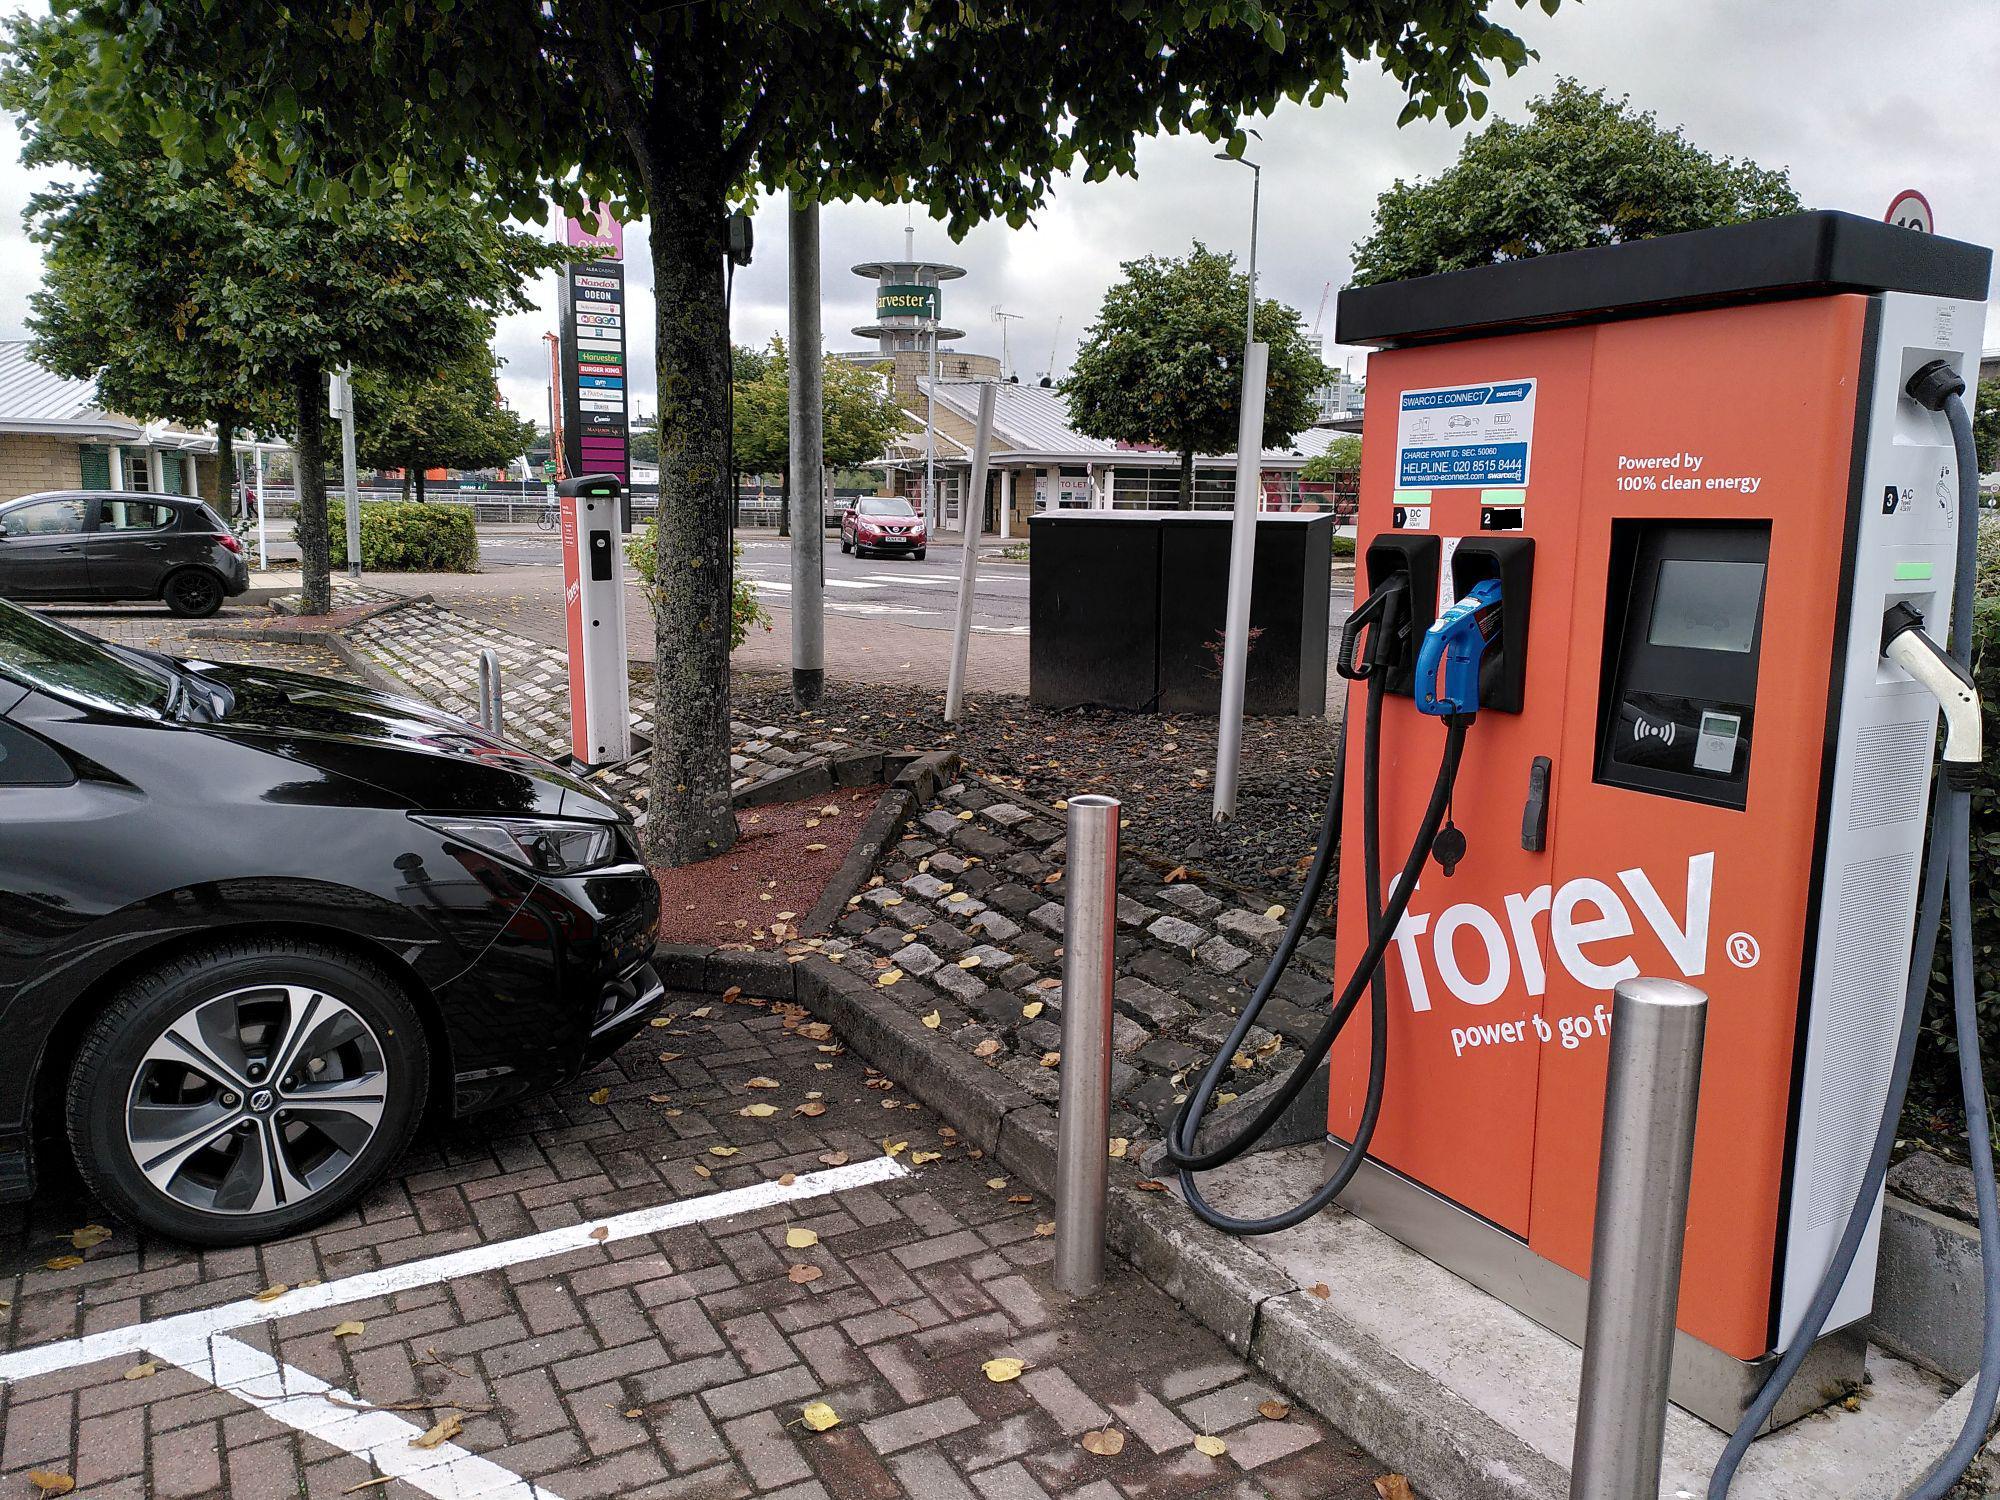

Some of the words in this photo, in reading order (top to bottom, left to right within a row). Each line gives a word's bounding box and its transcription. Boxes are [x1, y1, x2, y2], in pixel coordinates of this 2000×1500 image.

[580, 278, 615, 288] Nando's
[584, 289, 611, 300] ODEON
[581, 315, 616, 325] MECCA
[582, 352, 618, 362] Harvester
[580, 365, 604, 373] BURGER
[1402, 395, 1436, 407] SWARCO
[1403, 450, 1430, 460] CHARGE
[1430, 449, 1451, 459] POINT
[1451, 449, 1460, 458] ID:
[1461, 448, 1477, 457] SEC.
[1402, 462, 1451, 474] HELPLINE:
[1453, 460, 1471, 472] 020
[1472, 459, 1496, 471] 8515
[1498, 458, 1522, 470] 8444
[1618, 452, 1681, 470] Powered
[1684, 452, 1704, 472] by
[1401, 472, 1485, 482] www.swarco-econnect.com
[1616, 475, 1657, 491] 100%
[1661, 475, 1702, 490] clean
[1705, 477, 1762, 494] energy
[1886, 493, 1894, 507] 3
[1901, 488, 1914, 500] AC
[1396, 512, 1401, 523] 1
[1409, 509, 1422, 518] DC
[1484, 513, 1491, 524] 2
[1388, 851, 1715, 1013] forev
[1451, 1019, 1526, 1057] power
[1531, 1013, 1552, 1043] to
[1558, 1014, 1593, 1049] go
